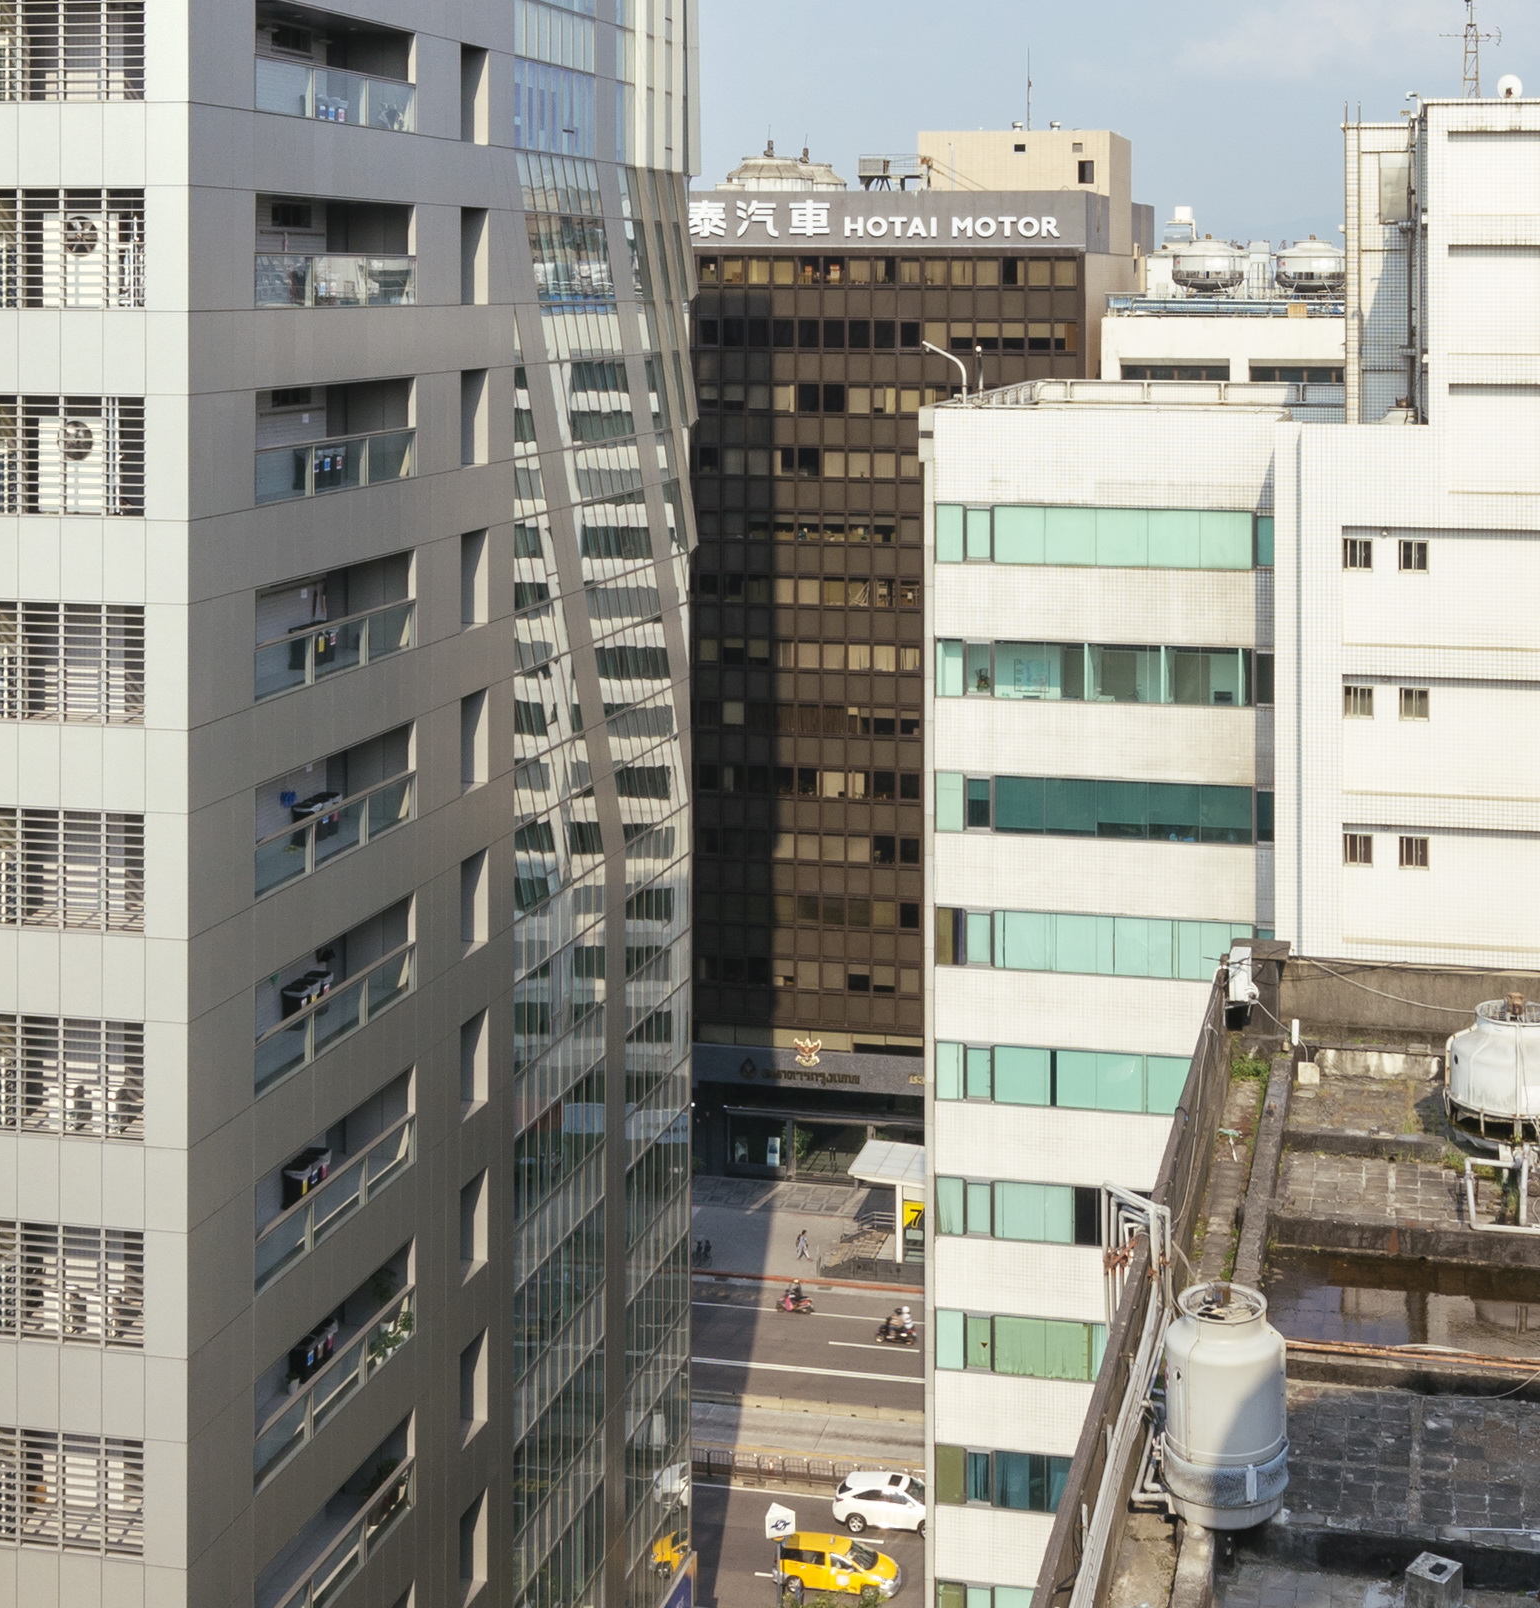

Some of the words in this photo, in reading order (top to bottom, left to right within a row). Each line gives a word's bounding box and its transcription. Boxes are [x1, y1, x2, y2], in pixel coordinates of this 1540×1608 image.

[688, 199, 830, 239] 泰汽車
[843, 216, 938, 239] HOTAI
[951, 215, 1062, 239] MOTOR
[910, 1209, 923, 1227] 7
